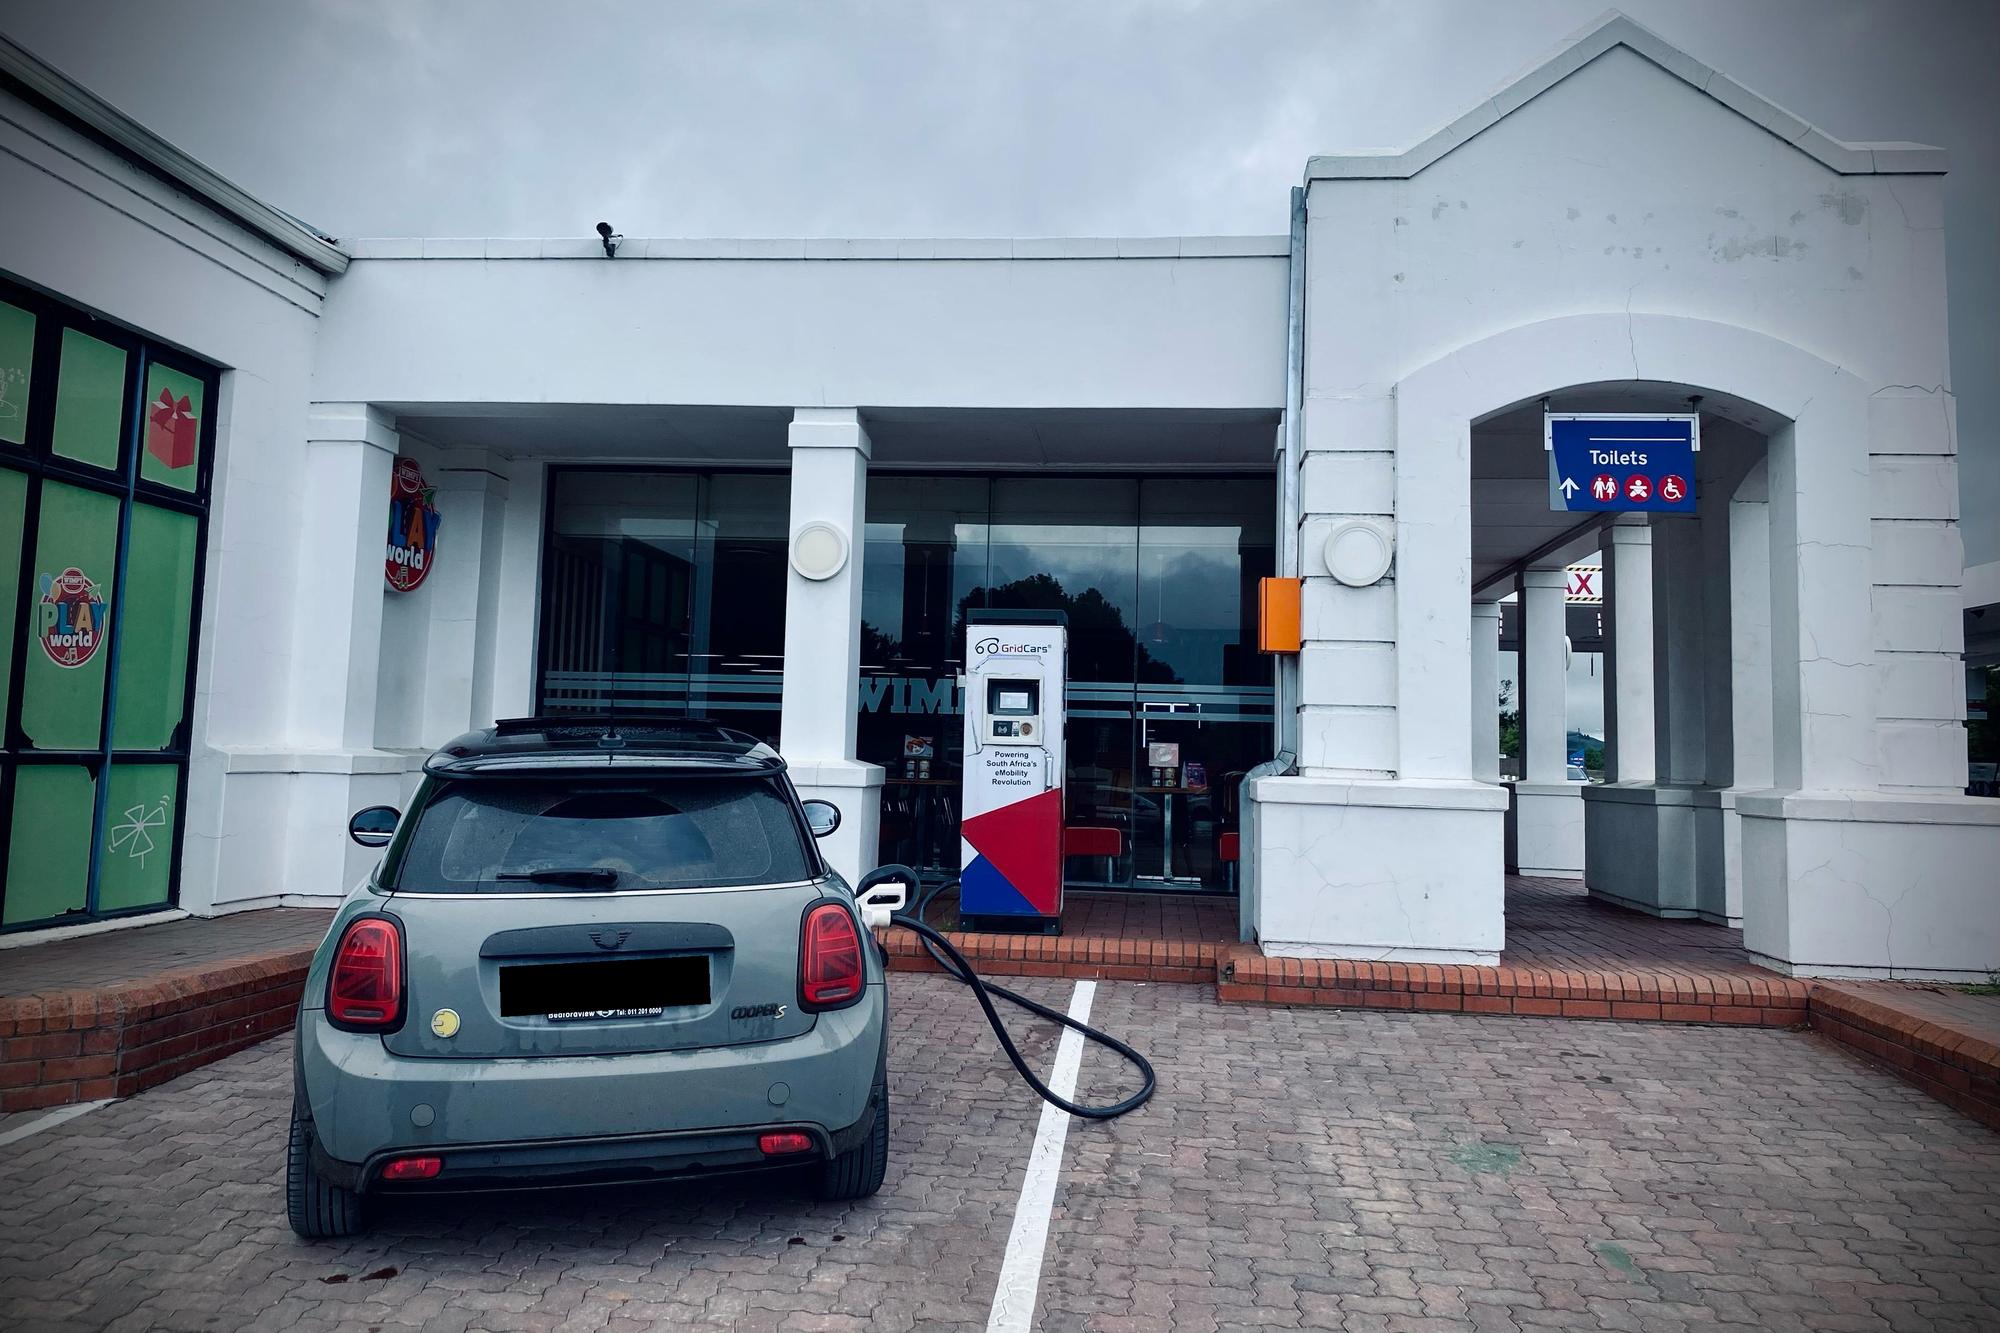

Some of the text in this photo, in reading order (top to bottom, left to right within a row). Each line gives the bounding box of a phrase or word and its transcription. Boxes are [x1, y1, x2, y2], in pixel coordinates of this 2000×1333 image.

[1589, 450, 1648, 466] Toilets
[388, 500, 441, 552] LAY
[38, 601, 107, 640] PLAY
[50, 630, 93, 647] world
[994, 751, 1029, 760] Powering
[994, 769, 1029, 778] eMobility
[991, 778, 1032, 786] Revolution
